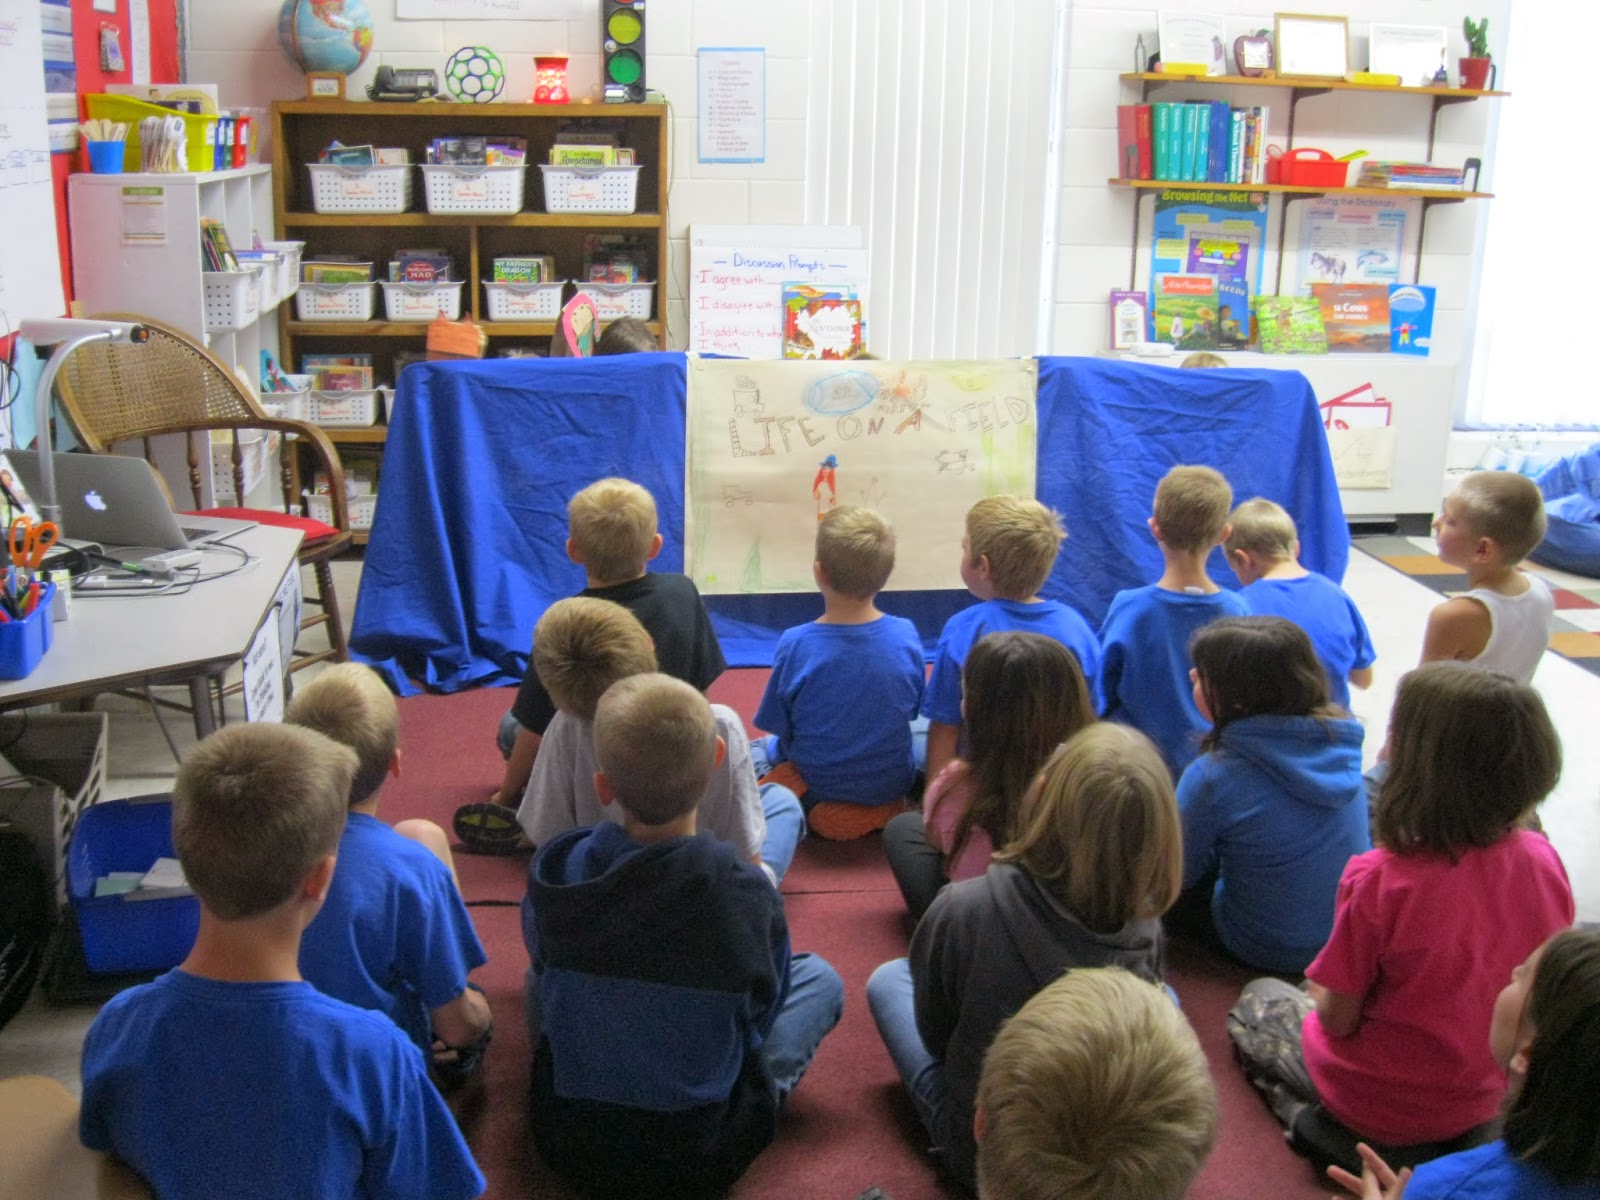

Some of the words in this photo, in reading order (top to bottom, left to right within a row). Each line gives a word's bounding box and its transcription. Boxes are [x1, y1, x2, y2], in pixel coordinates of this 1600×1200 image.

[1231, 122, 1240, 146] School
[1162, 189, 1214, 204] Browsing
[1215, 193, 1228, 202] the
[1229, 192, 1249, 203] Net
[1317, 199, 1339, 208] Using
[1340, 197, 1354, 206] the
[1355, 198, 1397, 208] Dictionary
[733, 252, 785, 268] Discussion
[789, 254, 826, 273] Prompts
[501, 267, 531, 275] DRAGON
[700, 269, 712, 284] I
[712, 275, 742, 290] agree
[744, 275, 763, 285] with
[1219, 284, 1246, 296] SEEDS
[698, 296, 710, 310] I
[711, 297, 753, 314] disagree
[1343, 302, 1368, 313] Cows
[699, 321, 712, 336] In
[714, 326, 755, 338] addition
[757, 329, 765, 337] to
[809, 323, 850, 336] NOVEMBER
[698, 339, 710, 349] I
[711, 340, 740, 351] think
[729, 415, 826, 458] LIFE
[836, 413, 884, 441] ON
[893, 409, 922, 435] A
[945, 395, 1030, 433] FIELD
